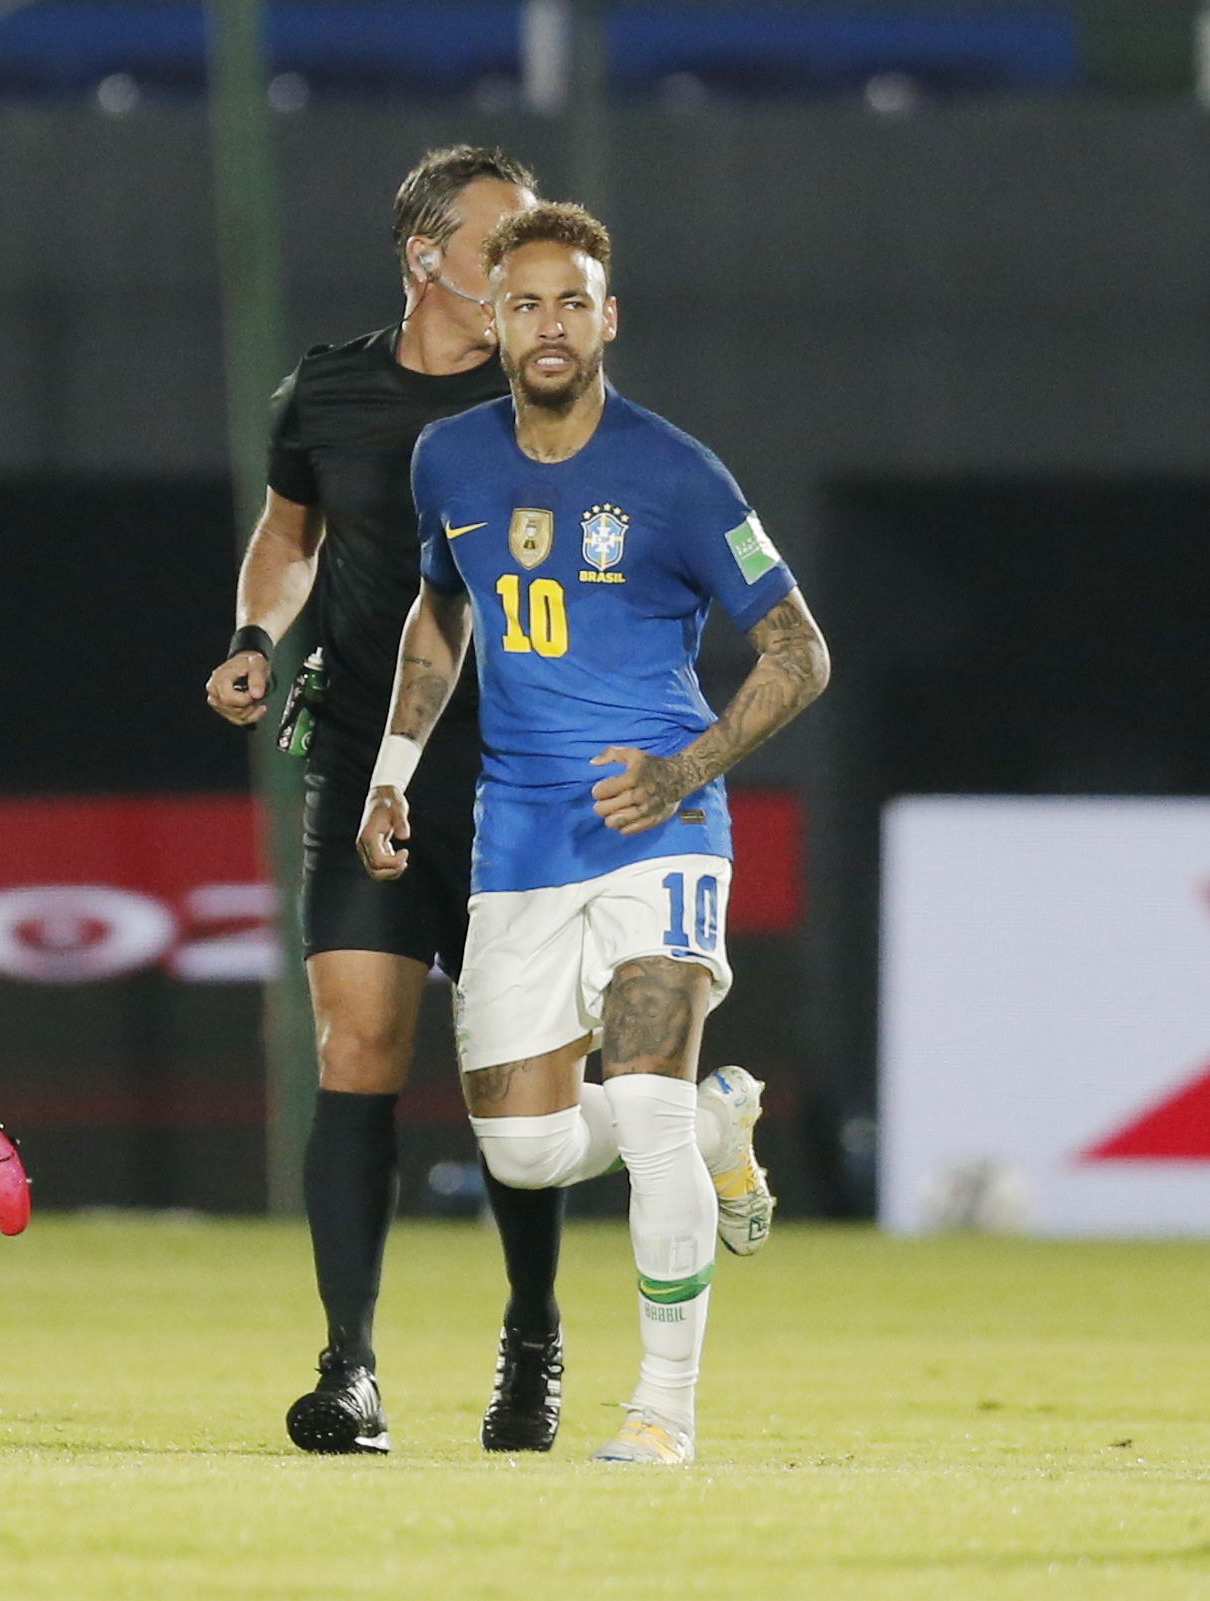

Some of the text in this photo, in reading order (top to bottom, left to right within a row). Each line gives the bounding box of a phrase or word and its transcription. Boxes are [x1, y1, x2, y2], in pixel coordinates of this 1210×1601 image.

[579, 570, 626, 583] BRASIL
[496, 574, 569, 658] 10
[662, 872, 717, 952] 10
[644, 1302, 687, 1322] BRASIL
